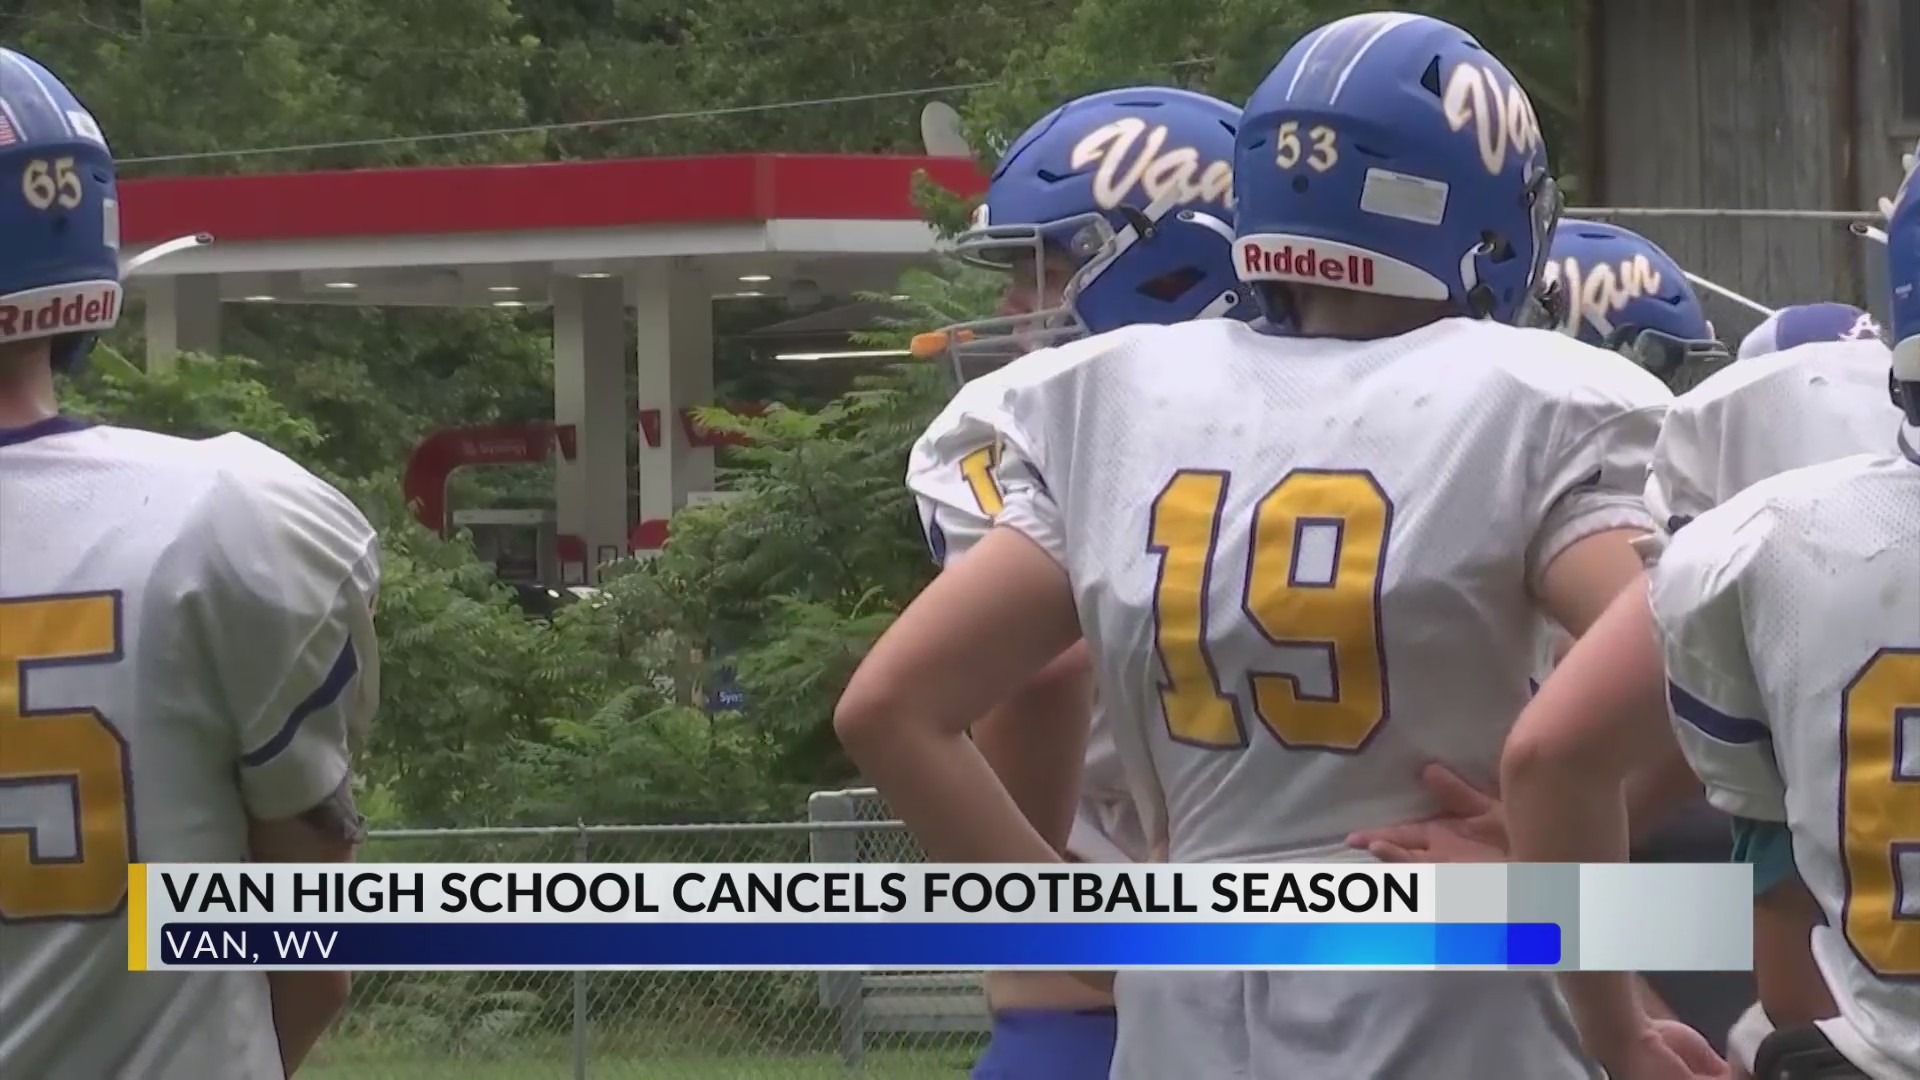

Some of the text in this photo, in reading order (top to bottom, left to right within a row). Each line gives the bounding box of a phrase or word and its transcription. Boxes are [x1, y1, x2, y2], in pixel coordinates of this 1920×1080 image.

[1275, 120, 1339, 173] 53
[22, 156, 82, 210] 65
[1244, 243, 1374, 287] Riddell
[0, 290, 116, 336] Riddell
[1146, 469, 1394, 753] 19
